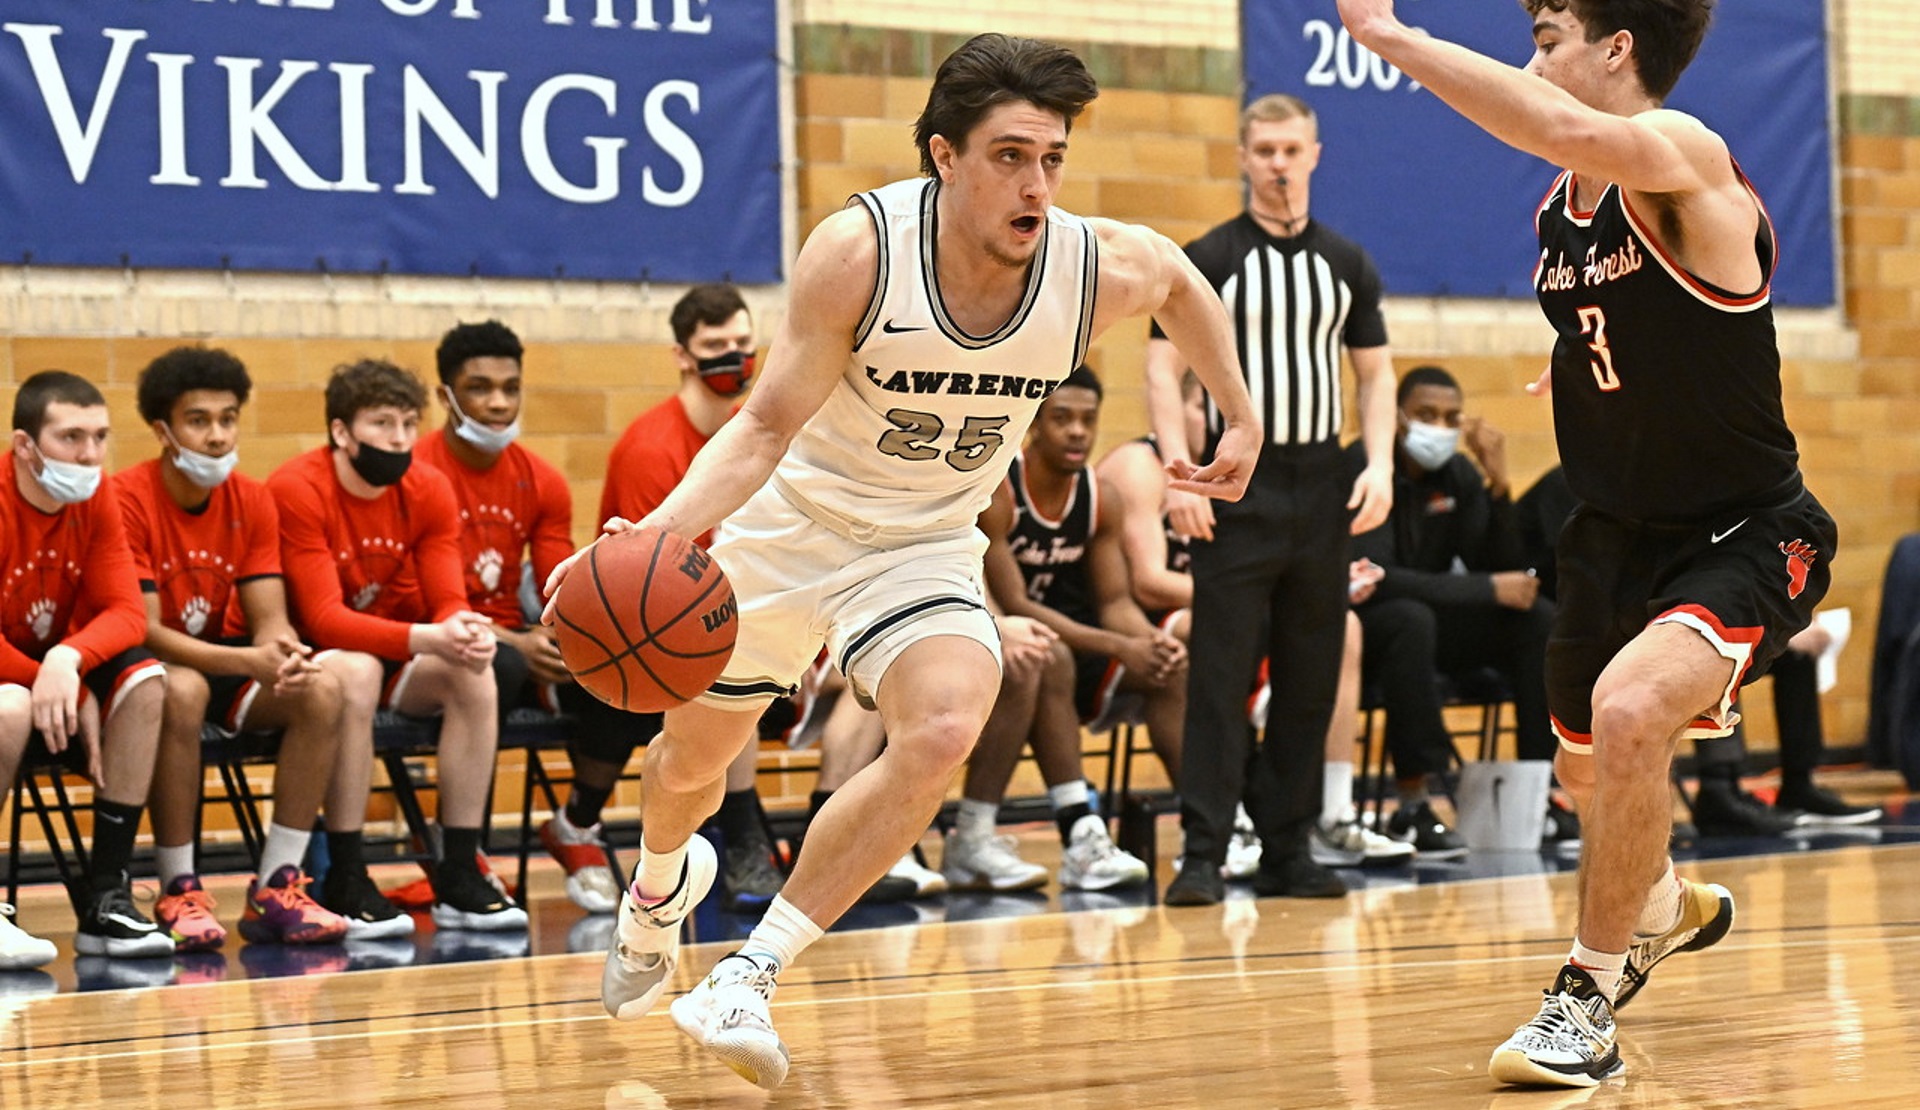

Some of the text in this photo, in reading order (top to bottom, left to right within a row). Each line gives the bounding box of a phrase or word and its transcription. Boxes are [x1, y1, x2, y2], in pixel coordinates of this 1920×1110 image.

[1303, 19, 1431, 93] 200
[3, 22, 704, 206] VIKINGS
[1582, 233, 1642, 287] Forest
[1575, 304, 1622, 393] 3
[876, 407, 1011, 472] 25
